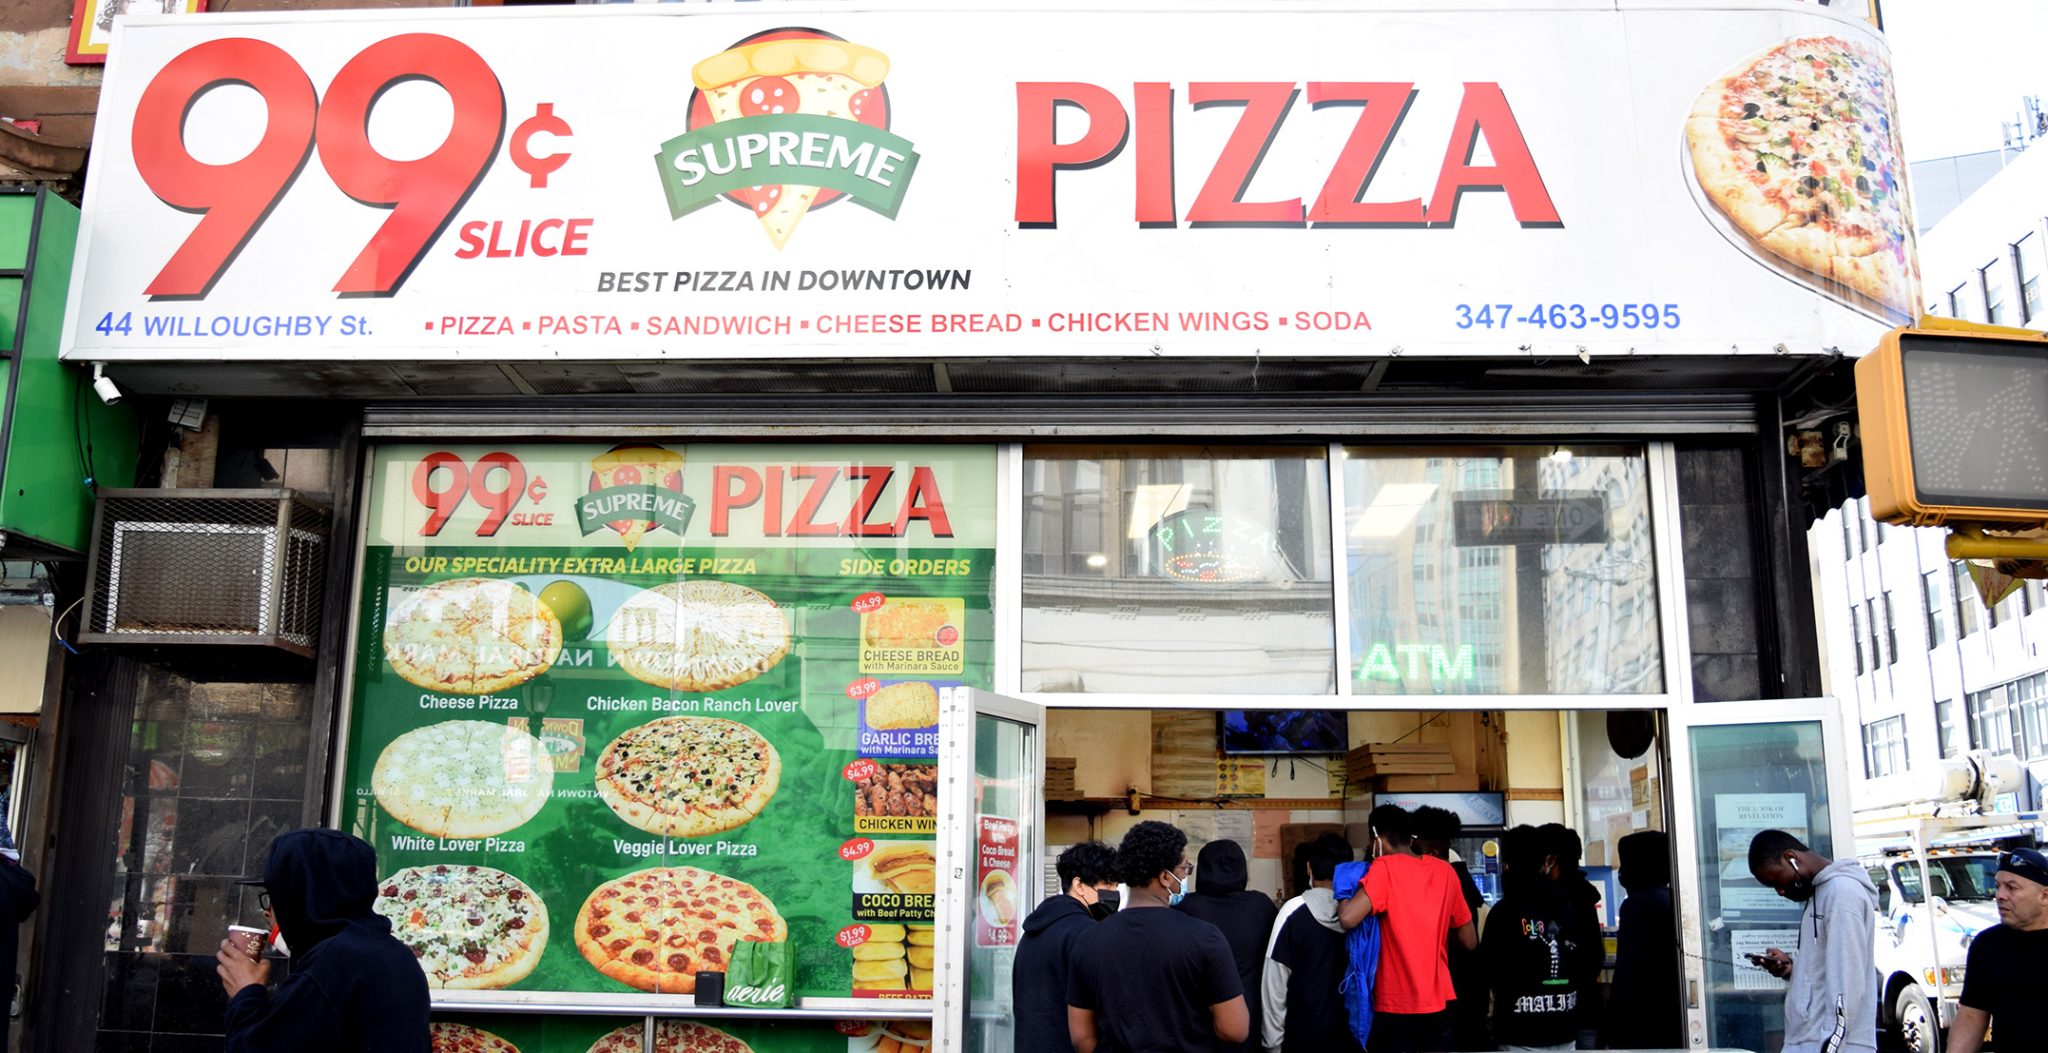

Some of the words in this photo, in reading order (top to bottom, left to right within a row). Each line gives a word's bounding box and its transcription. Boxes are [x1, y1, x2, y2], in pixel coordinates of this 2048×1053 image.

[673, 131, 906, 187] SUPREME
[1014, 81, 1566, 229] PIZZA
[454, 217, 594, 260] SLICE
[597, 271, 669, 293] BEST
[673, 270, 754, 292] PIZZA
[761, 270, 792, 292] IN
[797, 269, 972, 292] DOWNTOWN
[95, 311, 133, 337] 44
[143, 314, 332, 337] WILLOUGHBY
[339, 314, 373, 336] St.
[440, 316, 515, 336] PIZZA
[538, 315, 623, 335] PASTA
[646, 315, 791, 336] SANDWICH
[816, 314, 922, 334] CHEESE
[931, 313, 1023, 333] BREAD
[1047, 312, 1169, 332] CHICKEN
[1178, 311, 1270, 332] WINGS
[1295, 311, 1372, 331] SODA
[1455, 303, 1681, 330] 347-463-9595
[581, 492, 689, 522] SUPREME
[710, 465, 955, 539] PIZZA
[511, 512, 554, 527] SLICE
[1156, 516, 1277, 552] PIZZA
[405, 556, 447, 574] OUR
[451, 557, 560, 575] SPECIALITY
[562, 558, 627, 575] EXTRA
[629, 558, 696, 575] LARGE
[698, 558, 757, 575] PIZZA
[839, 559, 885, 576] SIDE
[888, 559, 971, 576] ORDERS
[855, 595, 882, 611] $4.99
[864, 650, 913, 662] CHEESE
[916, 650, 960, 662] BREAD
[1356, 643, 1476, 681] ATM
[864, 662, 884, 671] with
[887, 662, 928, 671] Marinara
[930, 663, 959, 671] Sauce
[849, 681, 877, 697] $3.99
[419, 694, 475, 710] Cheese
[479, 695, 519, 710] Pizza
[586, 696, 648, 711] Chicken
[651, 697, 699, 711] Bacon
[703, 697, 751, 712] Ranch
[755, 698, 799, 712] Lover
[861, 732, 911, 746] GARLIC
[914, 733, 939, 746] BRE
[861, 746, 882, 754] with
[886, 746, 926, 754] Marinara
[847, 764, 874, 780] $4.99
[859, 818, 913, 830] CHICKEN
[916, 818, 938, 830] WIN
[391, 836, 436, 851] White
[439, 837, 483, 851] Lover
[485, 838, 526, 852] Pizza
[613, 839, 664, 858] Veggie
[668, 840, 713, 855] Lover
[716, 841, 757, 856] Pizza
[842, 842, 870, 858] $4.99
[861, 894, 900, 908] COCO
[904, 895, 935, 908] BRE
[857, 909, 877, 918] with
[878, 909, 898, 918] Beef
[899, 909, 922, 920] Patty
[839, 926, 865, 942] $1.99
[726, 977, 785, 1004] aerie
